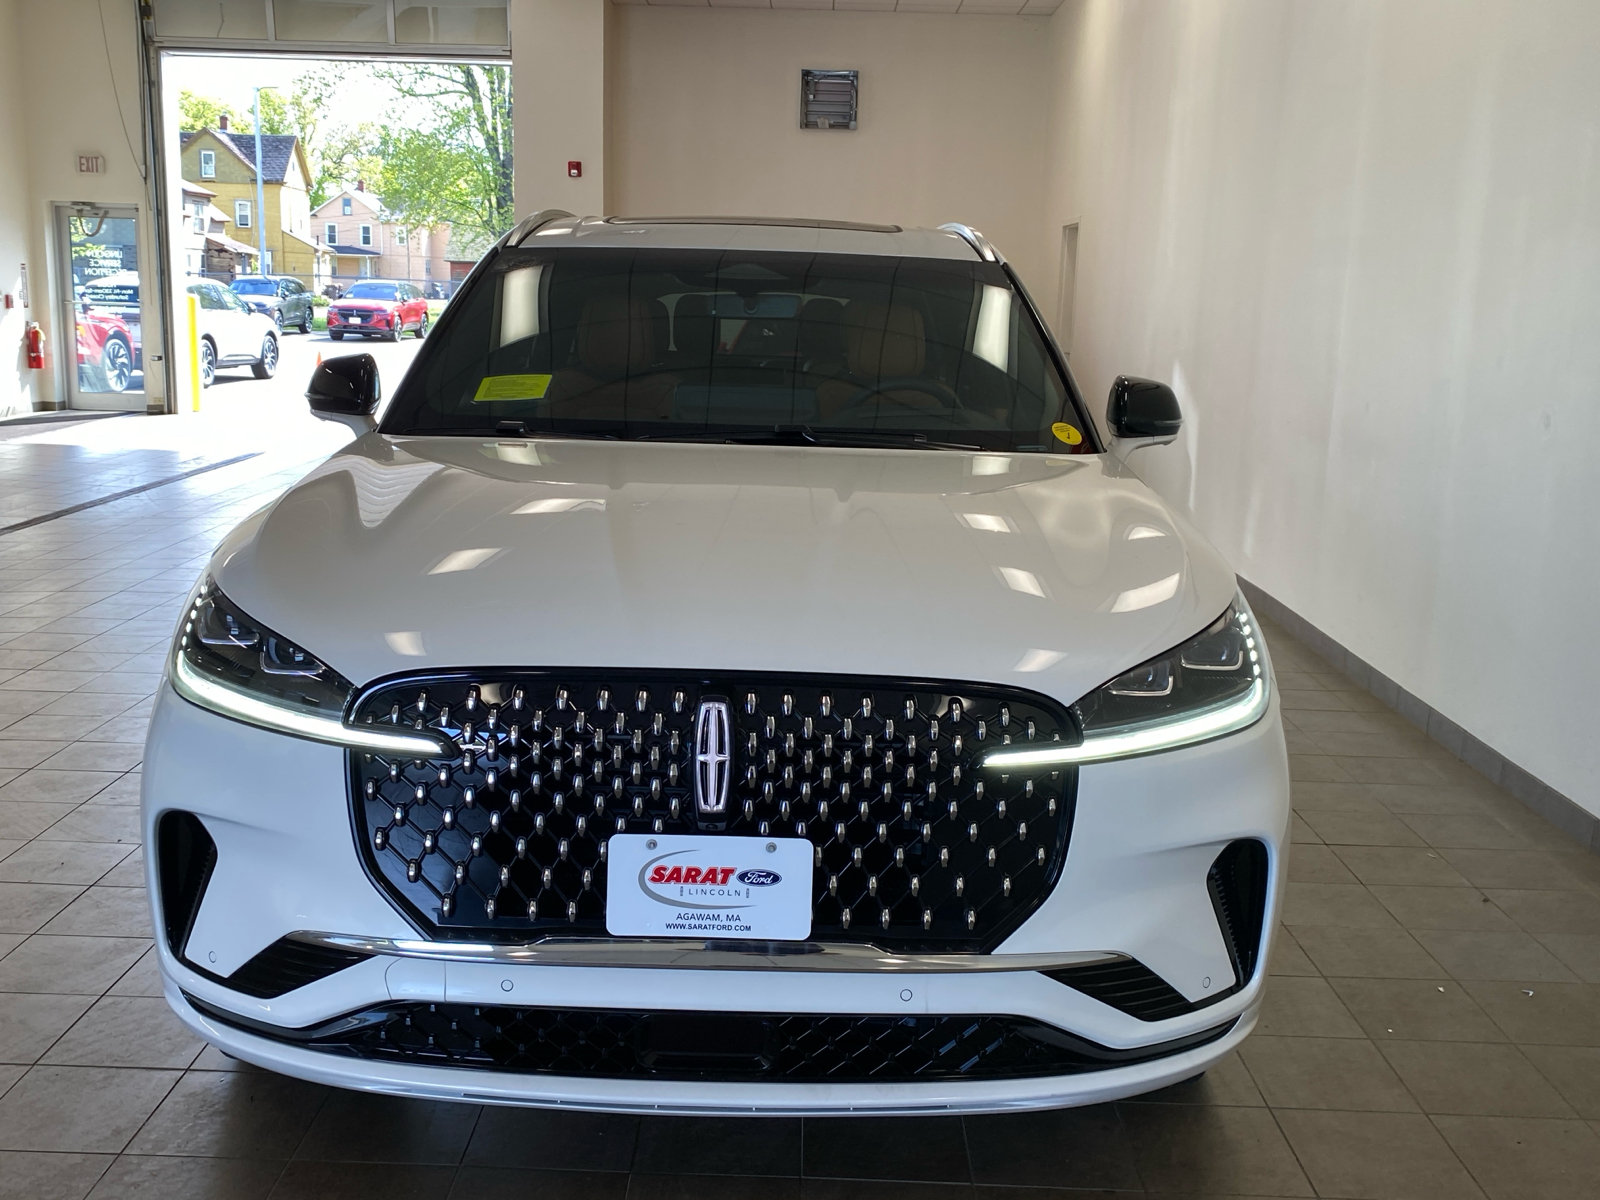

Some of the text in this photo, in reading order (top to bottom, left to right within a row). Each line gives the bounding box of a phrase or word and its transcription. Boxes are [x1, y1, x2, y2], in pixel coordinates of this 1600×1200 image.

[78, 156, 99, 173] EXIT
[647, 865, 773, 886] SARAT Ford
[688, 888, 741, 897] LINCOLN
[675, 912, 741, 923] AGAWAM, MA
[665, 922, 752, 932] WWW.SARATFORD.COM
